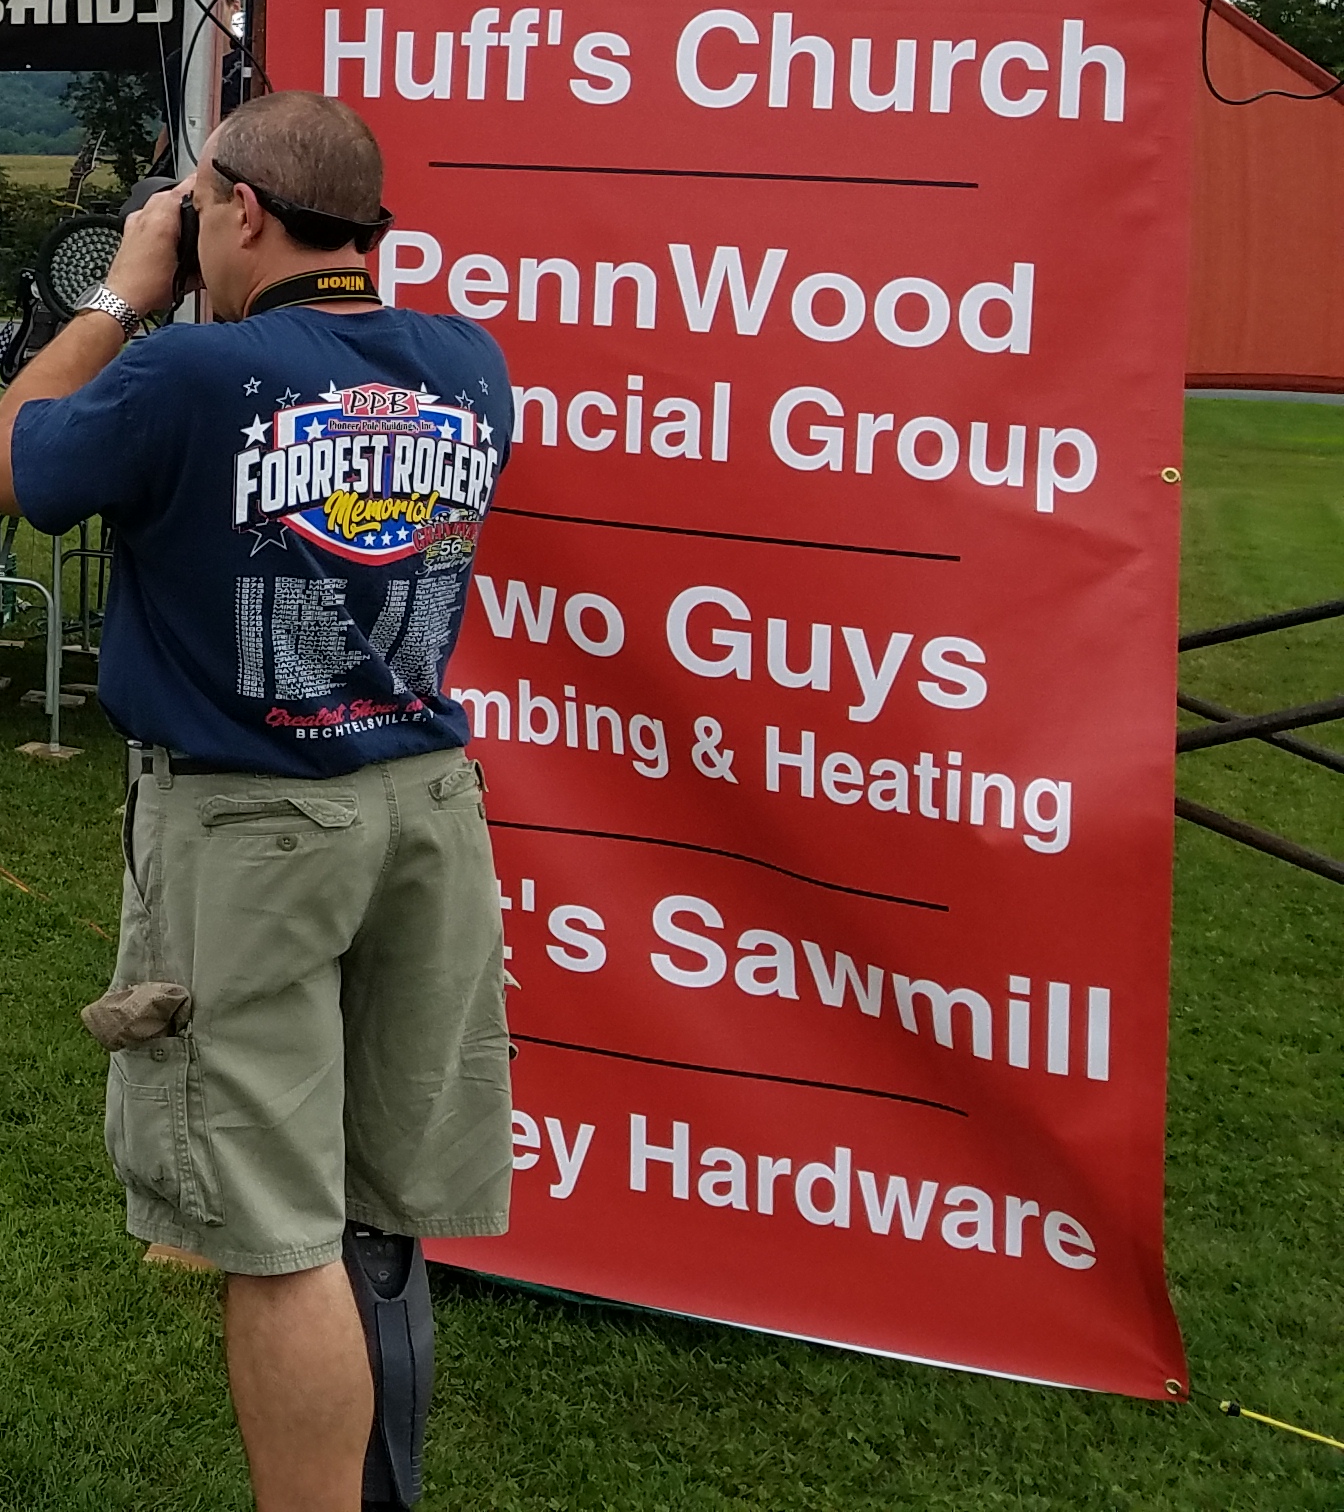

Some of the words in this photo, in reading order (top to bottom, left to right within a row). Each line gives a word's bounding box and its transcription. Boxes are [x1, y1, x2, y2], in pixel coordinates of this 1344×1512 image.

[324, 7, 631, 105] Huff's
[676, 8, 1126, 123] Church
[317, 275, 365, 291] Nikon
[378, 230, 1034, 354] PennWood
[328, 419, 359, 431] Pioneer
[362, 420, 380, 430] Pole
[350, 389, 409, 414] PPB
[511, 375, 730, 463] ncial
[770, 385, 1098, 513] Group
[234, 434, 389, 526] FORREST
[391, 434, 498, 516] ROGERS
[323, 489, 439, 540] Memorial
[439, 538, 463, 555] 56
[474, 574, 624, 658] wo
[667, 585, 989, 724] Guys
[265, 703, 348, 727] Greatest
[451, 678, 669, 780] mbing
[692, 716, 739, 785] &
[766, 726, 1072, 854] Heating
[498, 878, 607, 973] 's
[650, 894, 1110, 1082] Sawmill
[511, 1109, 596, 1199] ey
[629, 1113, 1097, 1271] Hardware
